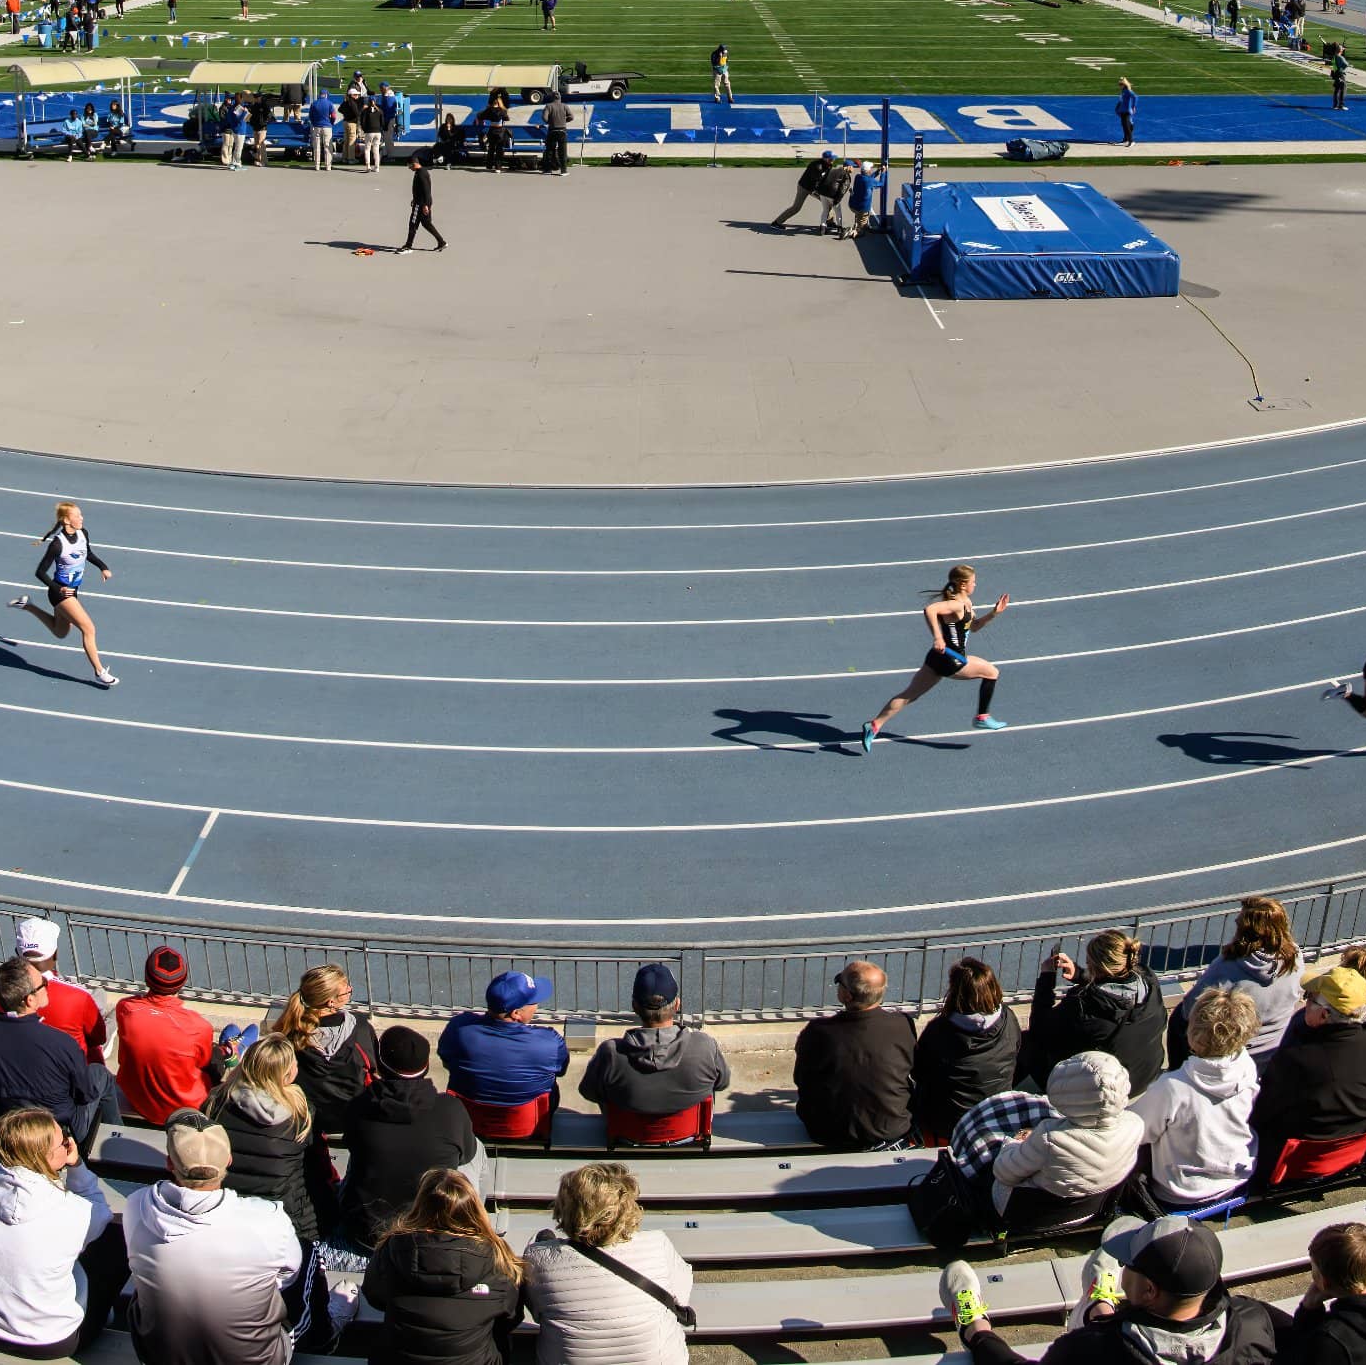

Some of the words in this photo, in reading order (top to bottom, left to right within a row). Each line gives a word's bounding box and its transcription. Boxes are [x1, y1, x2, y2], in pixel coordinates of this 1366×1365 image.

[915, 143, 923, 186] DRAKE
[914, 192, 922, 241] RELAYS
[1054, 272, 1084, 284] GILL
